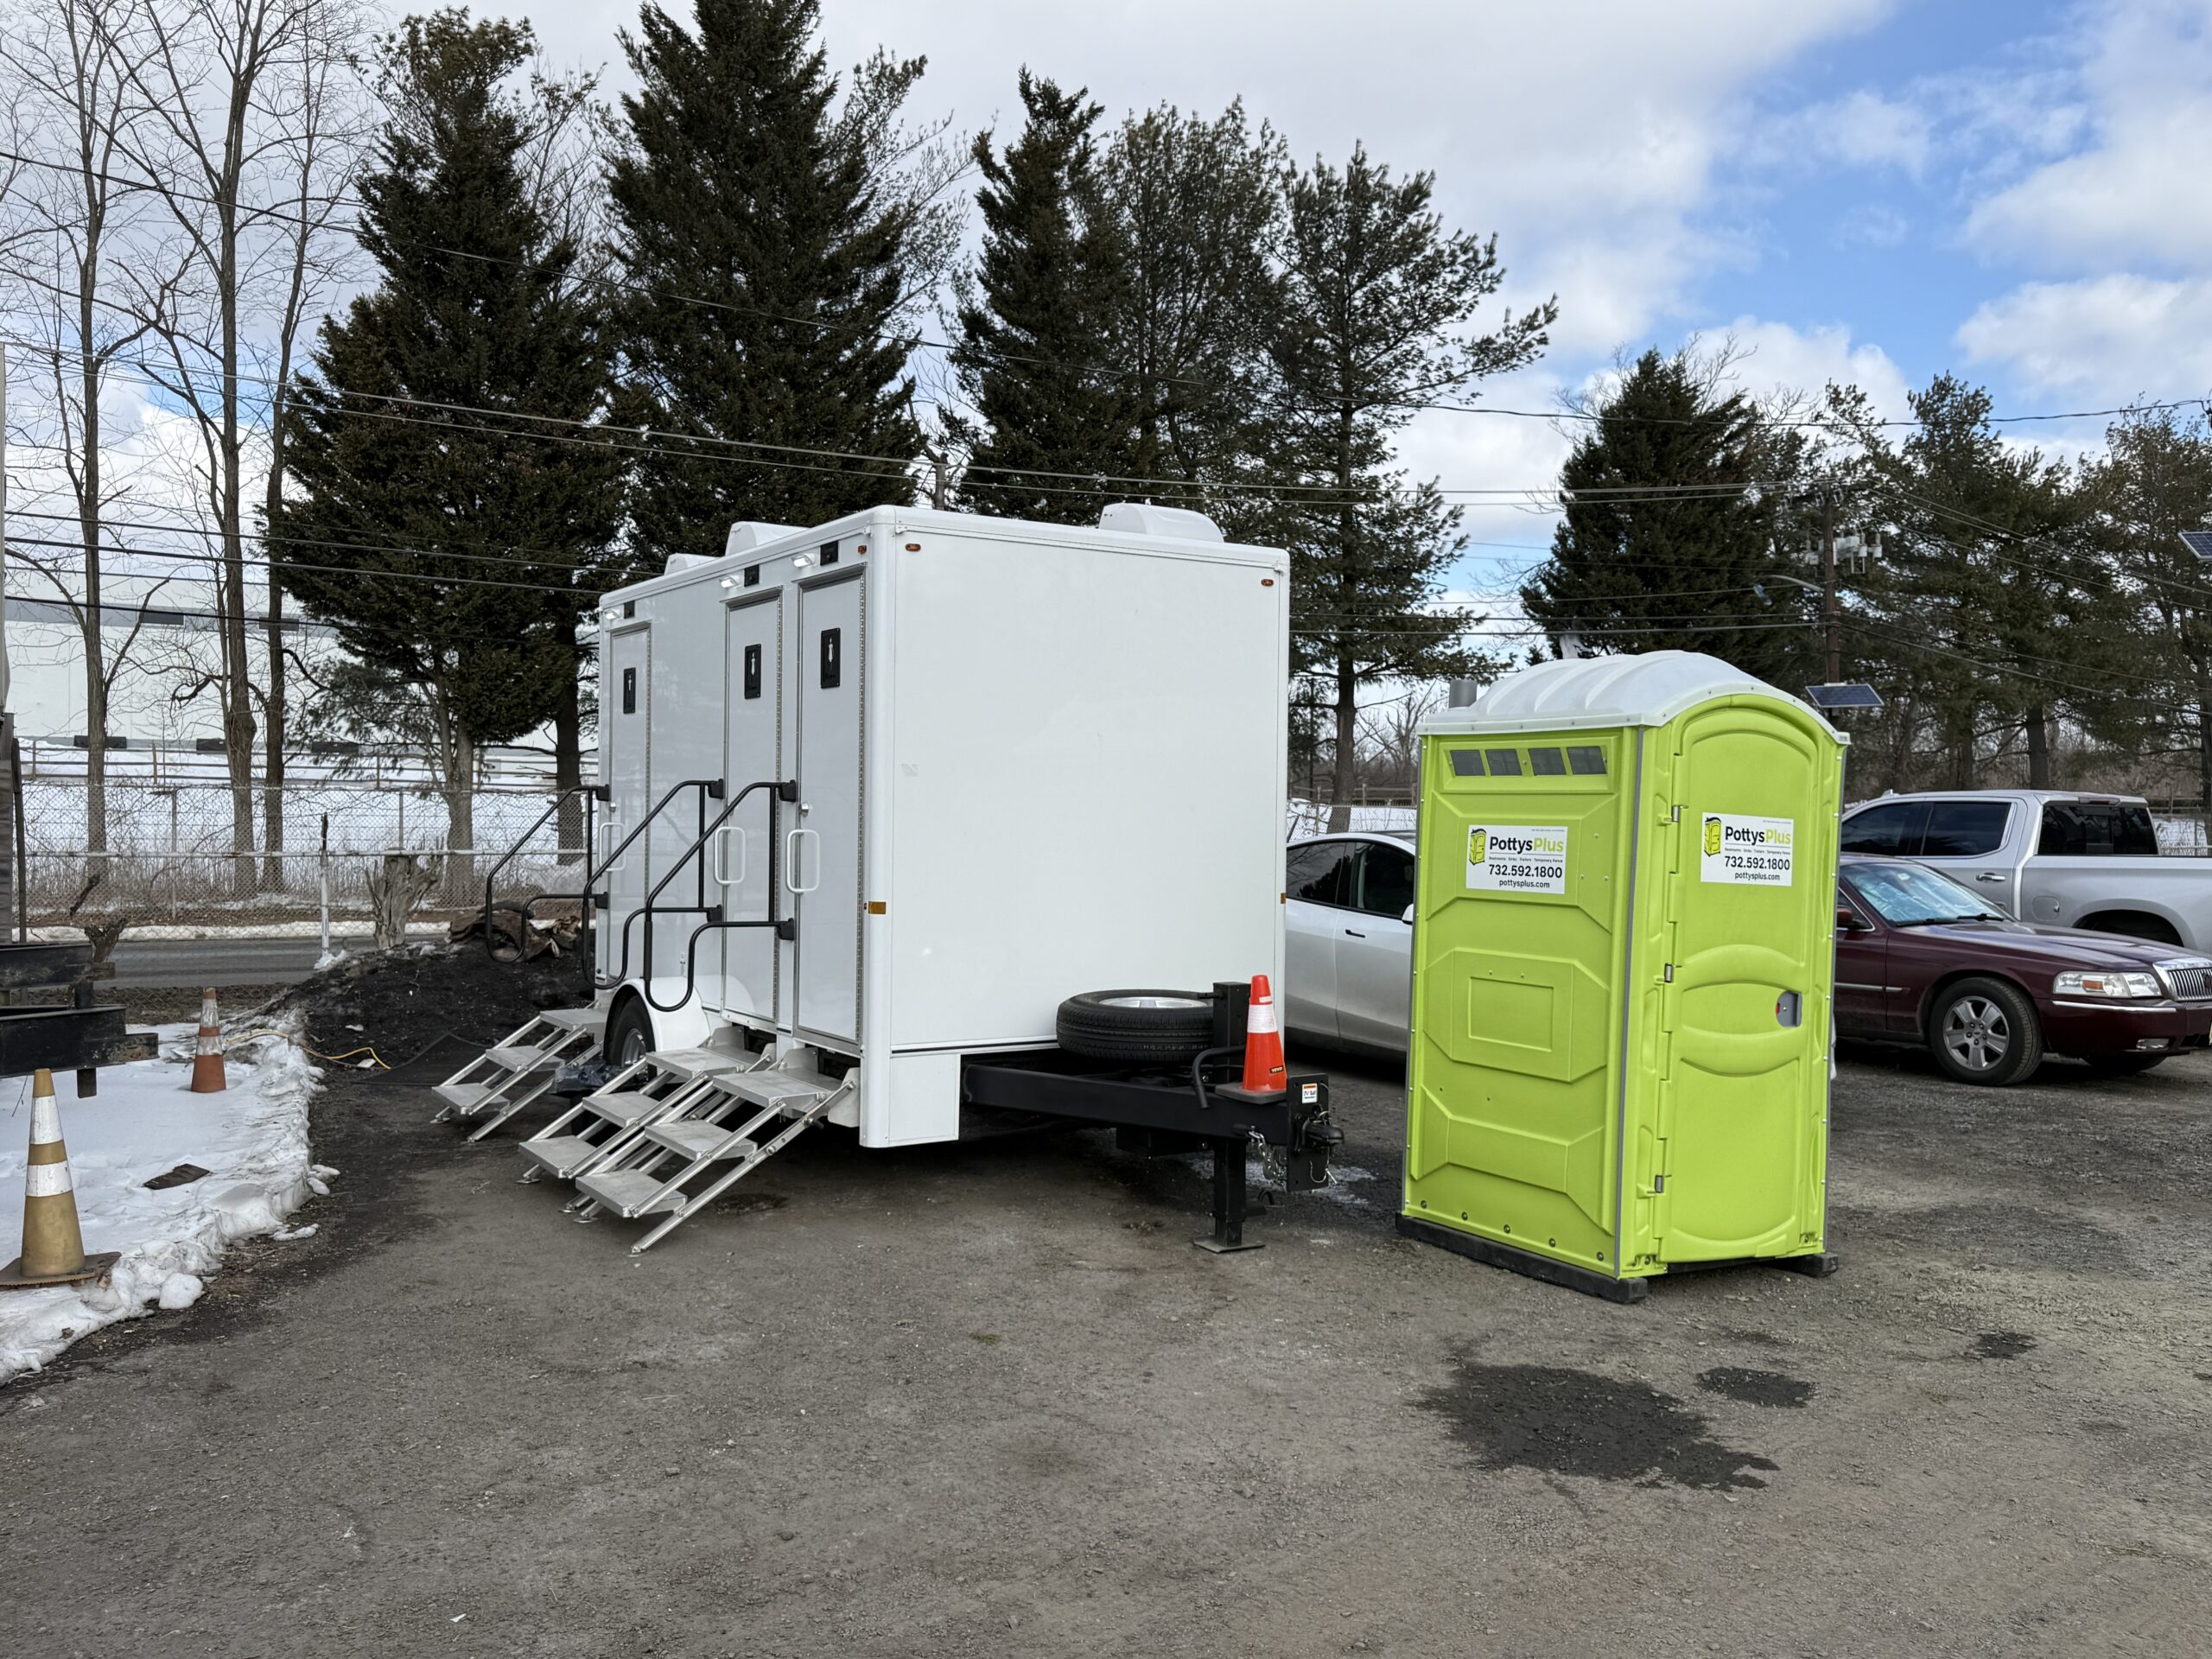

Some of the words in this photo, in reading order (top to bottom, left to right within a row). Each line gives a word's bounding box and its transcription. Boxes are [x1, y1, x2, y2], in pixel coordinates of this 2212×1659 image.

[1726, 826, 1791, 846] PottysPlus
[1490, 836, 1563, 855] PottysPlus
[1725, 855, 1790, 870] 732.592.1800
[1489, 864, 1563, 879] 732.592.1800
[1735, 872, 1780, 880] pottysplus.com
[1499, 880, 1550, 888] pottysplus.com
